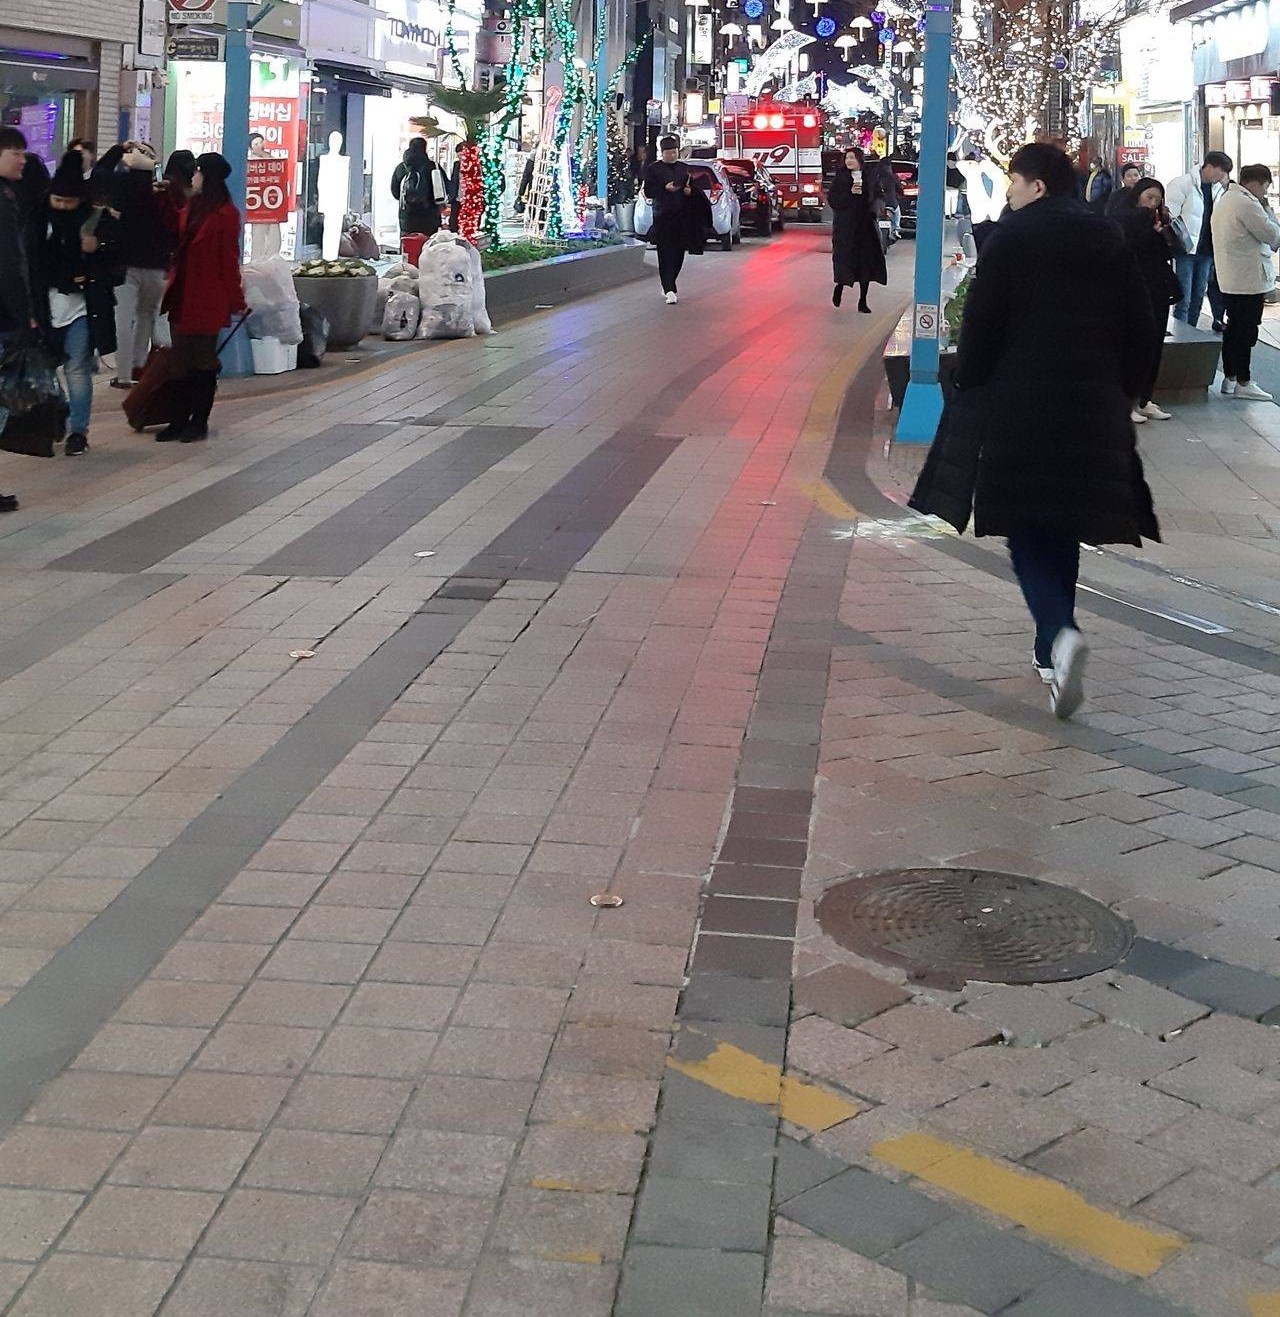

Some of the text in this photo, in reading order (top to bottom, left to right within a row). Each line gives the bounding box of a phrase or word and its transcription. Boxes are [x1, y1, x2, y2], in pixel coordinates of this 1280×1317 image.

[171, 12, 213, 20] NO SMOKING
[246, 185, 284, 211] 50
